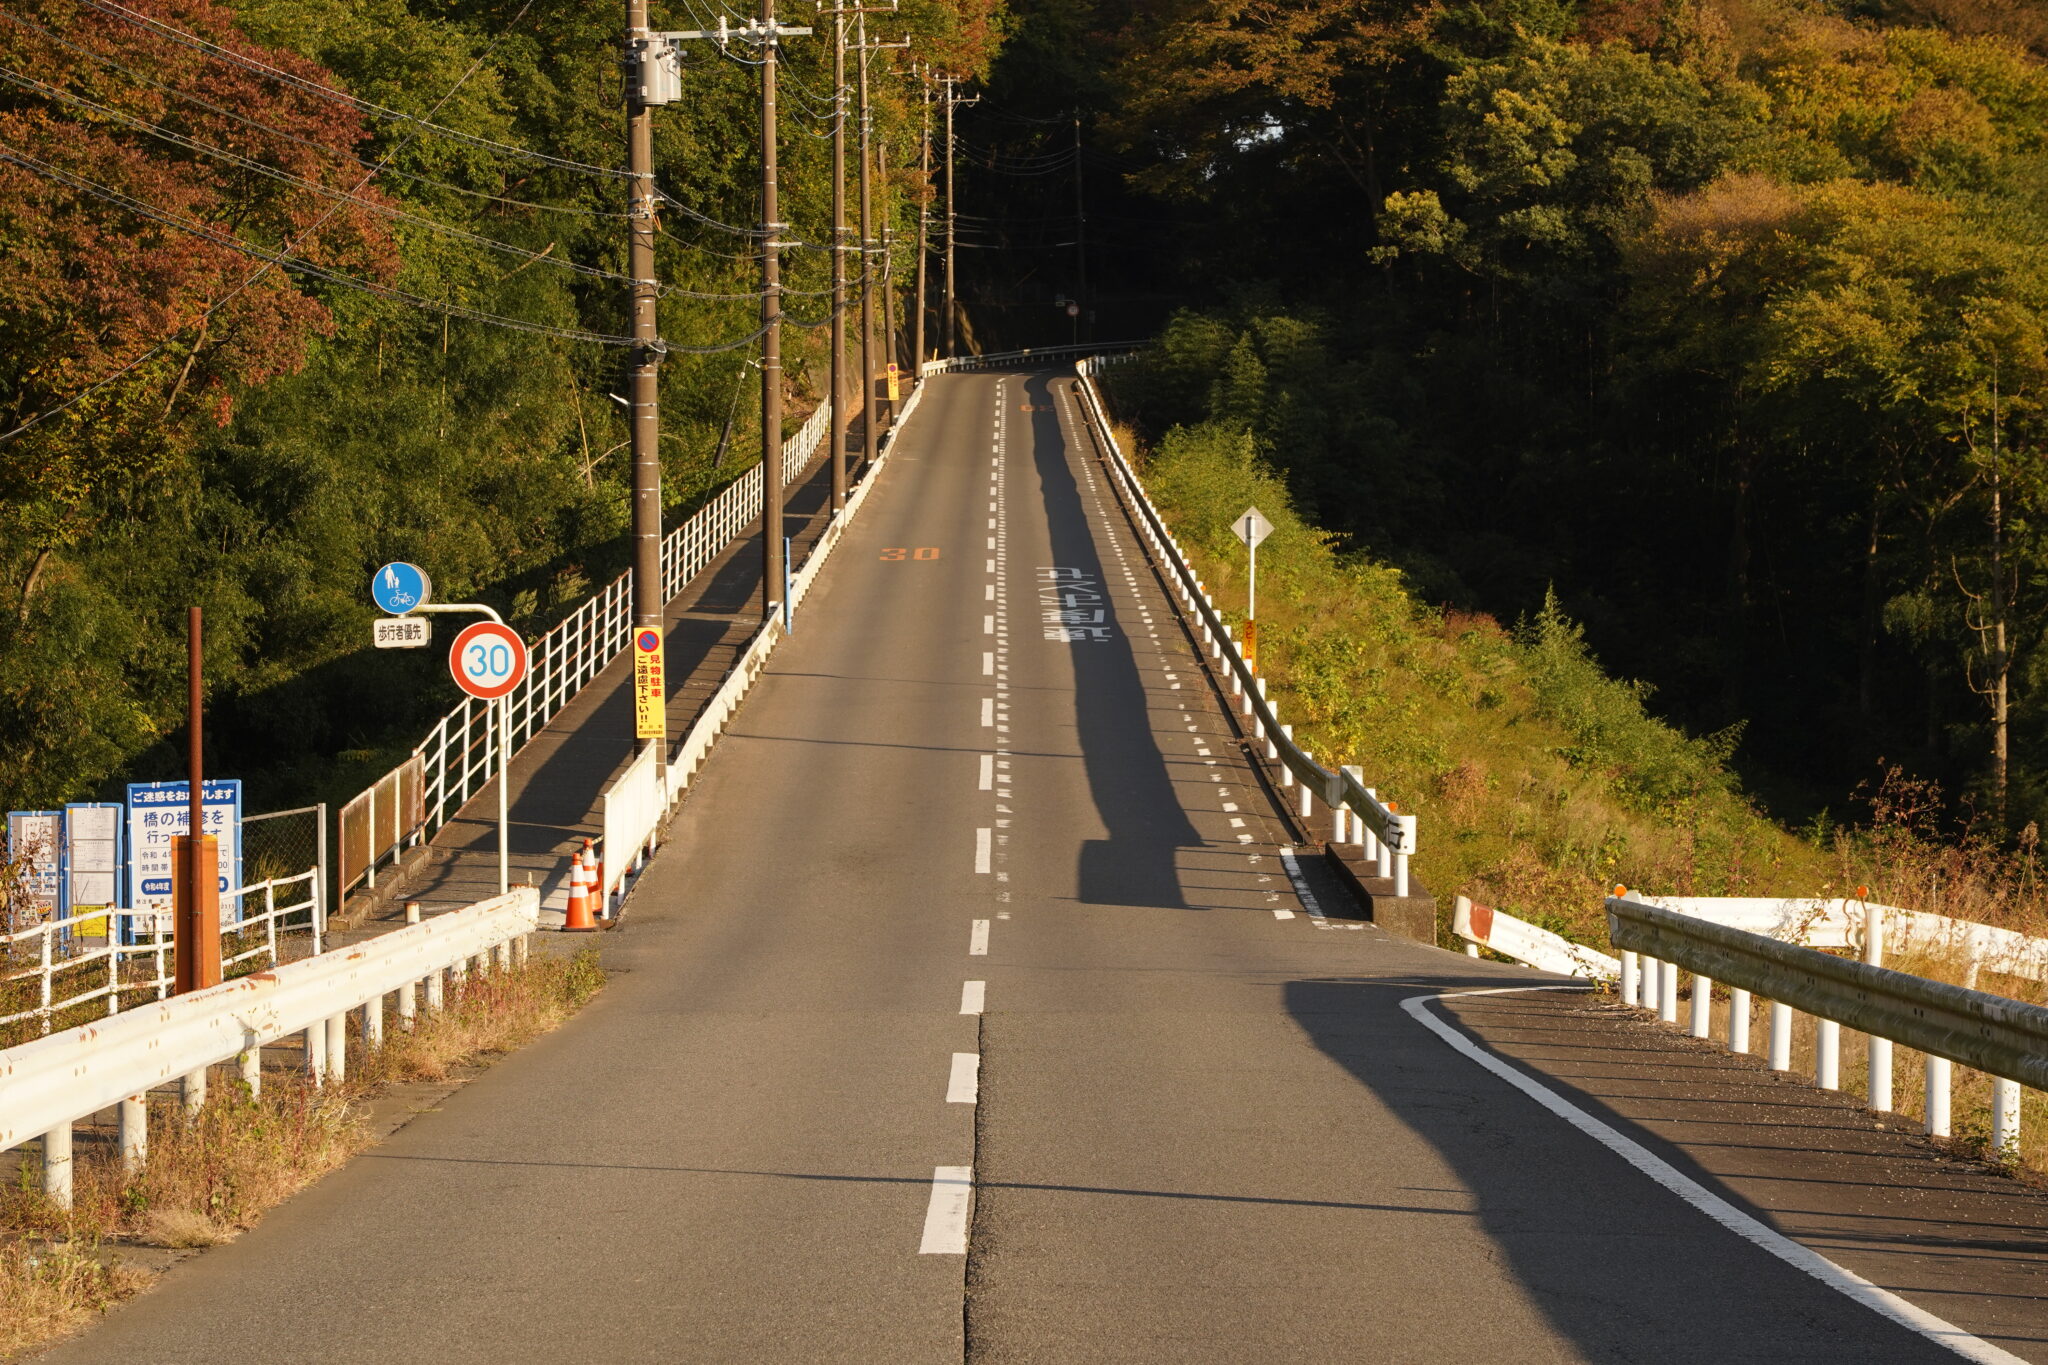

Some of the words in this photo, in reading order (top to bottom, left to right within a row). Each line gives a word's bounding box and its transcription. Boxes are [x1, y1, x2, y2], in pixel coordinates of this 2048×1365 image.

[879, 547, 940, 561] 30
[378, 623, 422, 641] 歩行者優先
[468, 644, 509, 677] 30
[650, 655, 661, 697] 見物駐車
[133, 789, 234, 803] ご迷惑をおします
